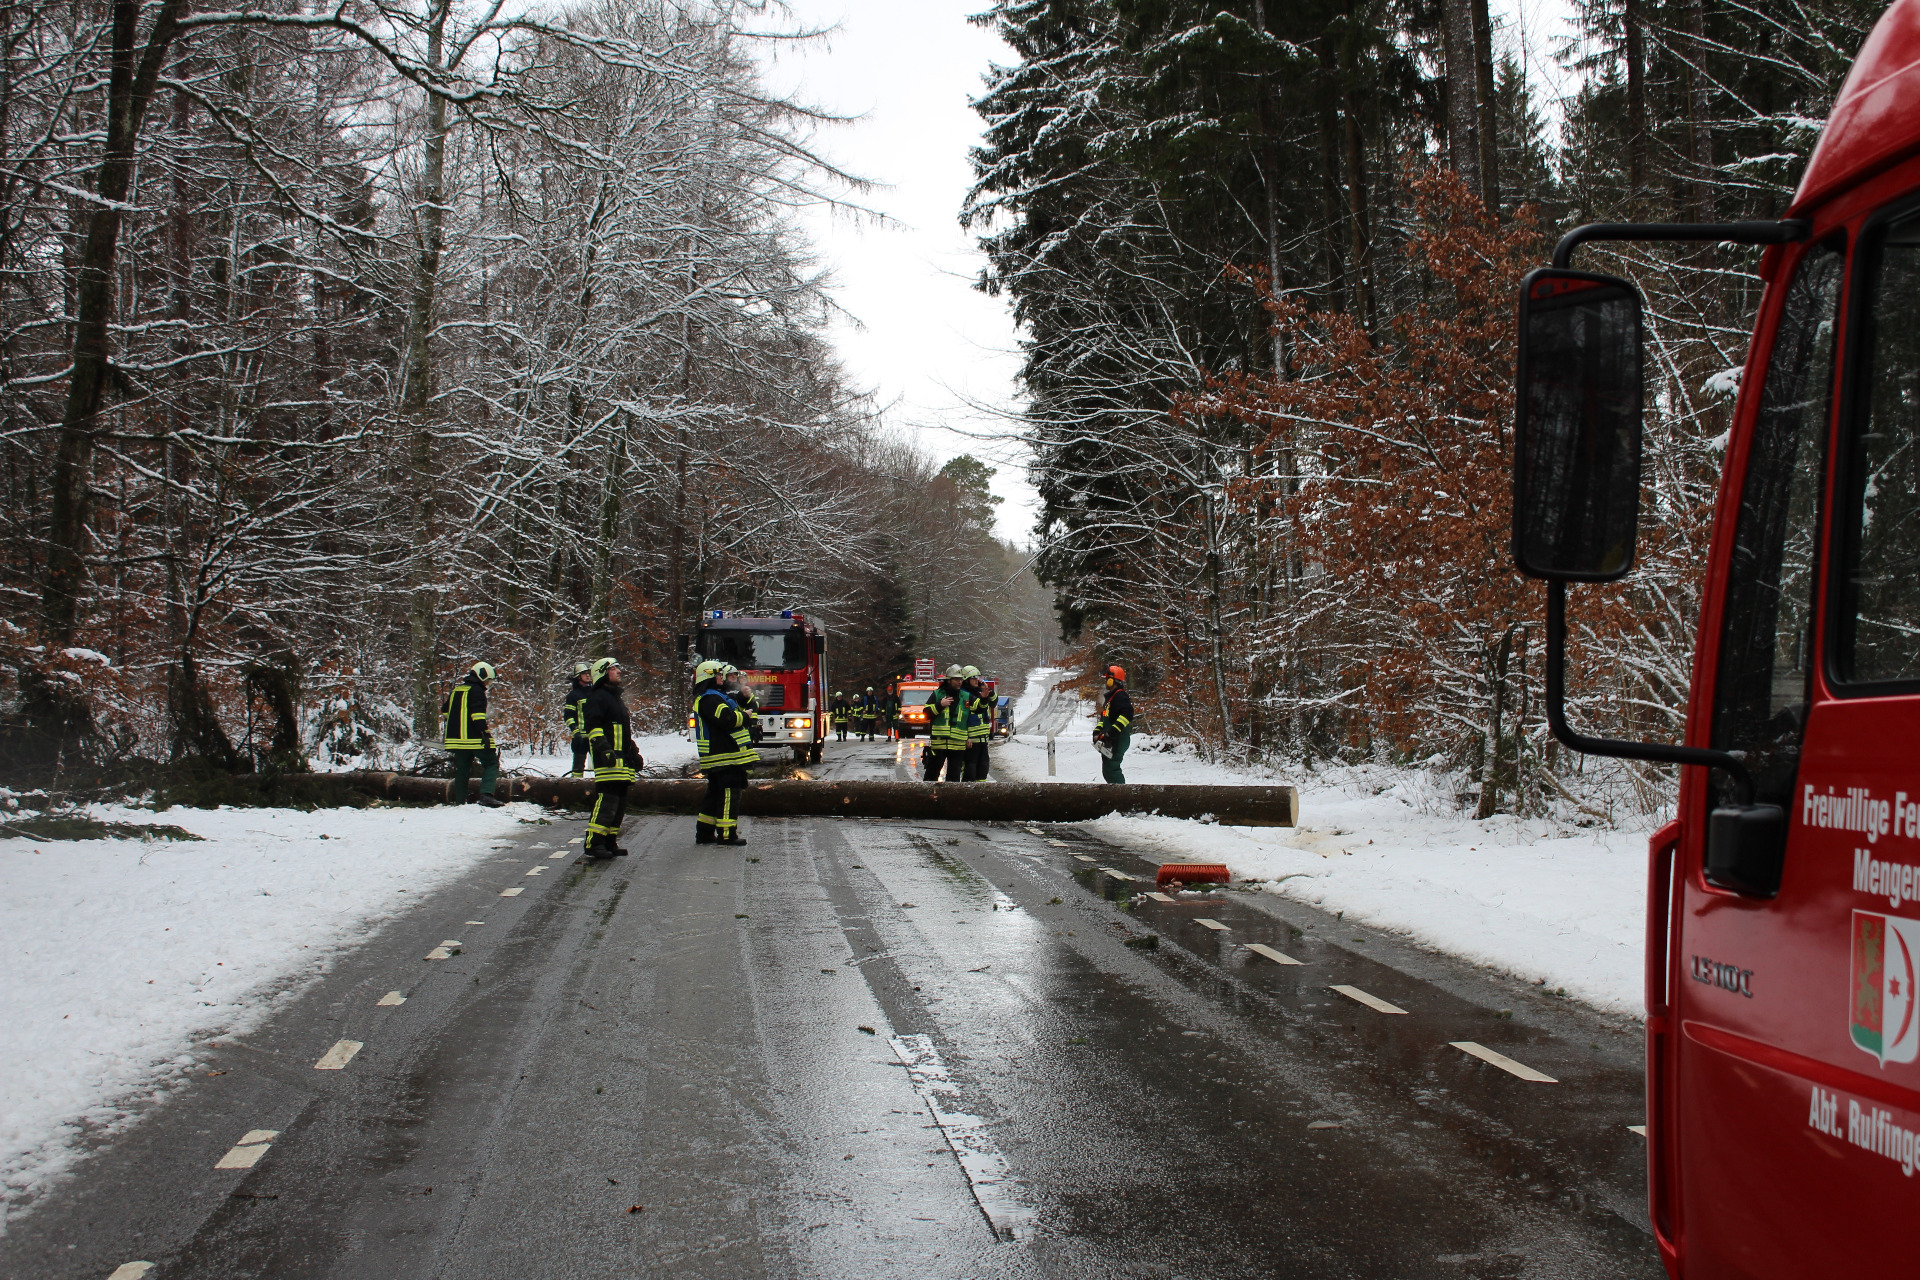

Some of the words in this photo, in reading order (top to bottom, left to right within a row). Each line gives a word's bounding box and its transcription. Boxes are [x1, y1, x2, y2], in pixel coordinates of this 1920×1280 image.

[1803, 784, 1889, 843] Freiwillige
[1853, 848, 1920, 909] Mengen
[1809, 1086, 1842, 1139] Abt.
